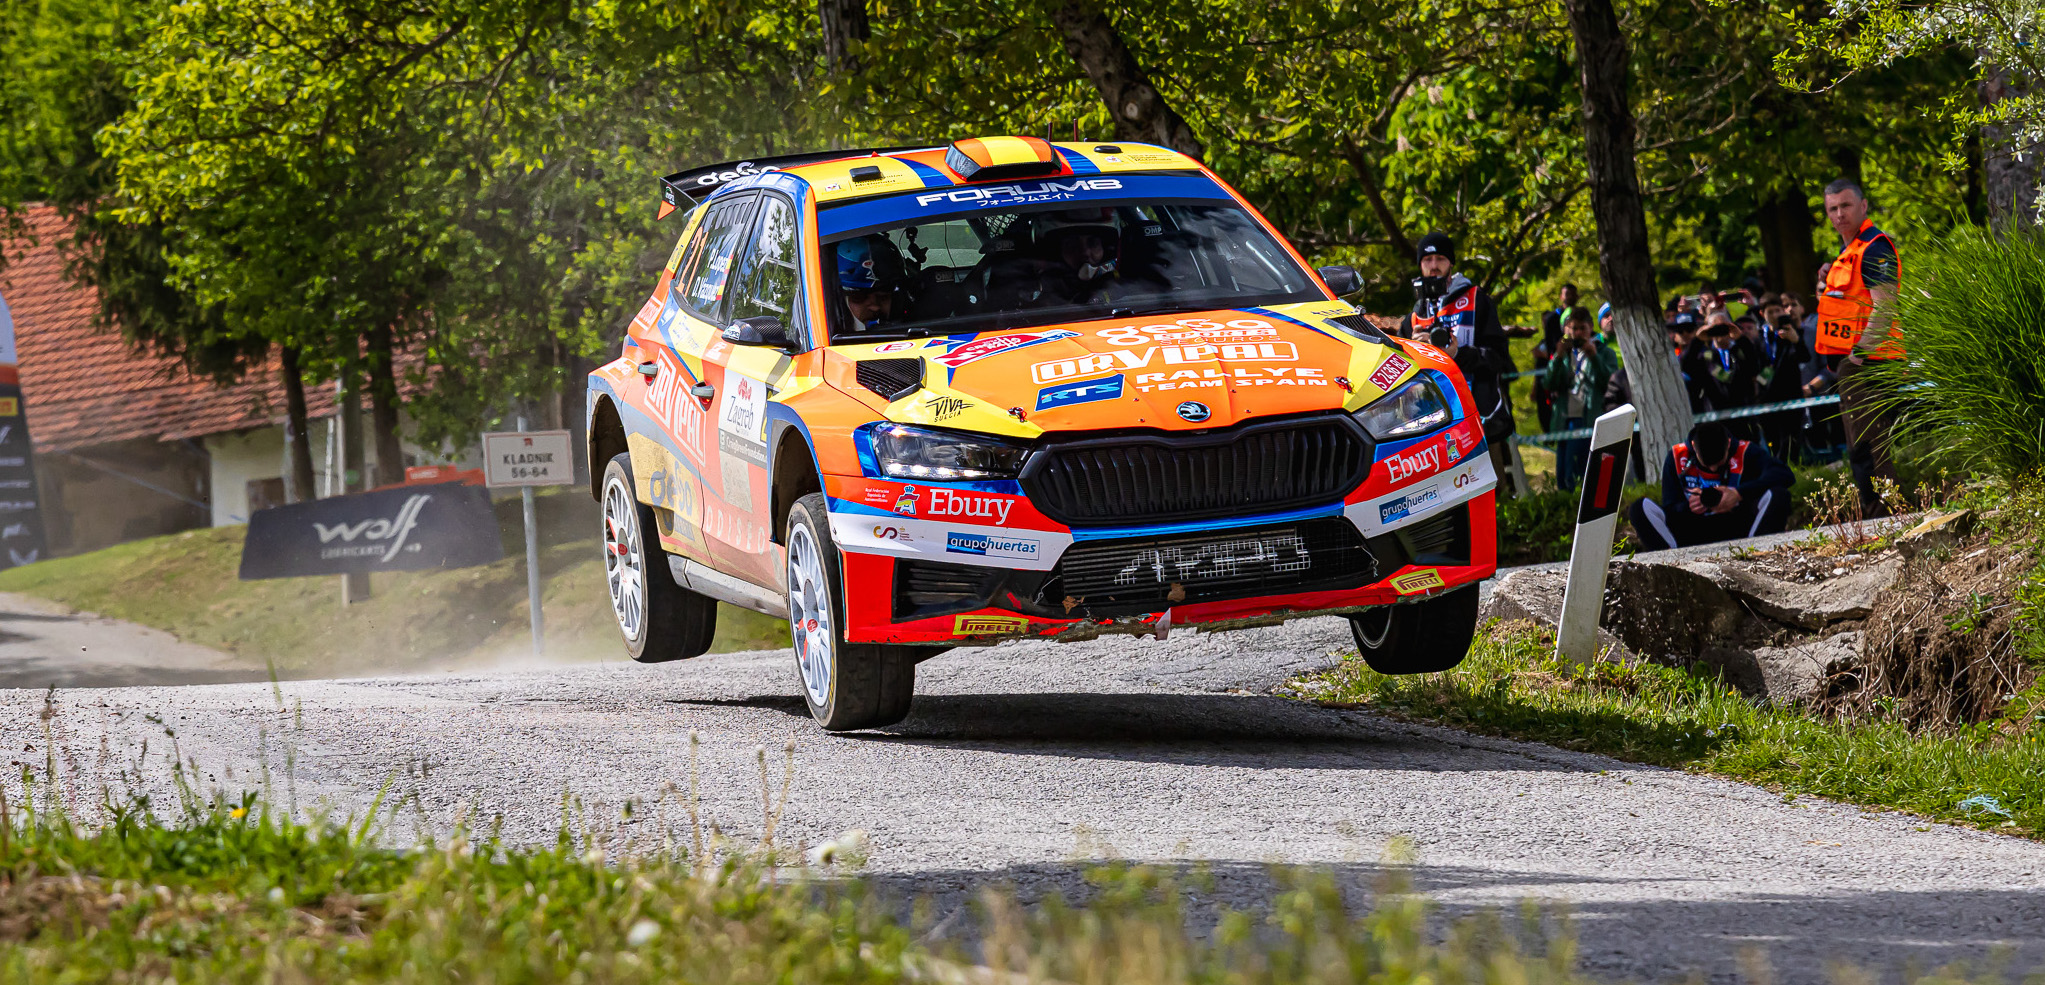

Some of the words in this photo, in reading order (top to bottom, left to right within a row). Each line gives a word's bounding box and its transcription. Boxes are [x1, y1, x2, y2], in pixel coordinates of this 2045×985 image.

[916, 178, 1123, 207] FORUM8
[977, 192, 1075, 207] フォーラムエイト
[1160, 329, 1271, 340] SPORTS
[1823, 321, 1851, 339] 128
[1160, 335, 1281, 345] SEGUROS
[1136, 367, 1324, 385] RALLYE
[1376, 363, 1401, 384] 2436
[1041, 381, 1120, 404] RTS
[1136, 379, 1223, 392] TEAM
[1236, 378, 1328, 387] SPAIN
[726, 395, 754, 433] Zagreb
[930, 397, 970, 416] VIVA
[934, 410, 962, 422] SUECIA
[1384, 444, 1440, 484] Ebury
[927, 488, 1014, 525] Ebury
[1381, 489, 1437, 520] grupohuertas
[312, 494, 432, 563] wolf
[950, 536, 1037, 553] grupohuertas
[1396, 572, 1440, 591] PIRELLI
[960, 618, 1021, 632] PIRELLI
